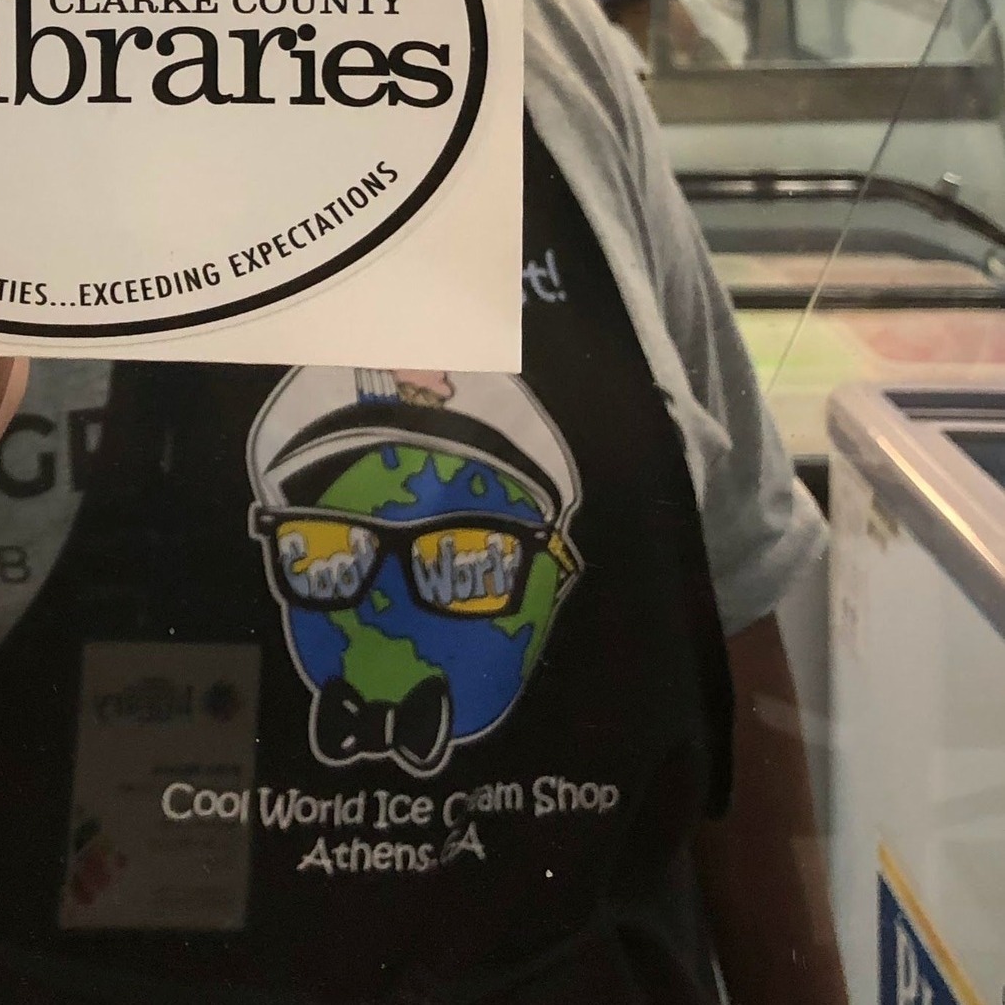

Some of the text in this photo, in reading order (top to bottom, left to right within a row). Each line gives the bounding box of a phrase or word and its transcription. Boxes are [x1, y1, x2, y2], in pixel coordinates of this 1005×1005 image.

[228, 160, 399, 278] EXPECTATIONS
[161, 775, 620, 830] Cool World Ice Cam Shop
